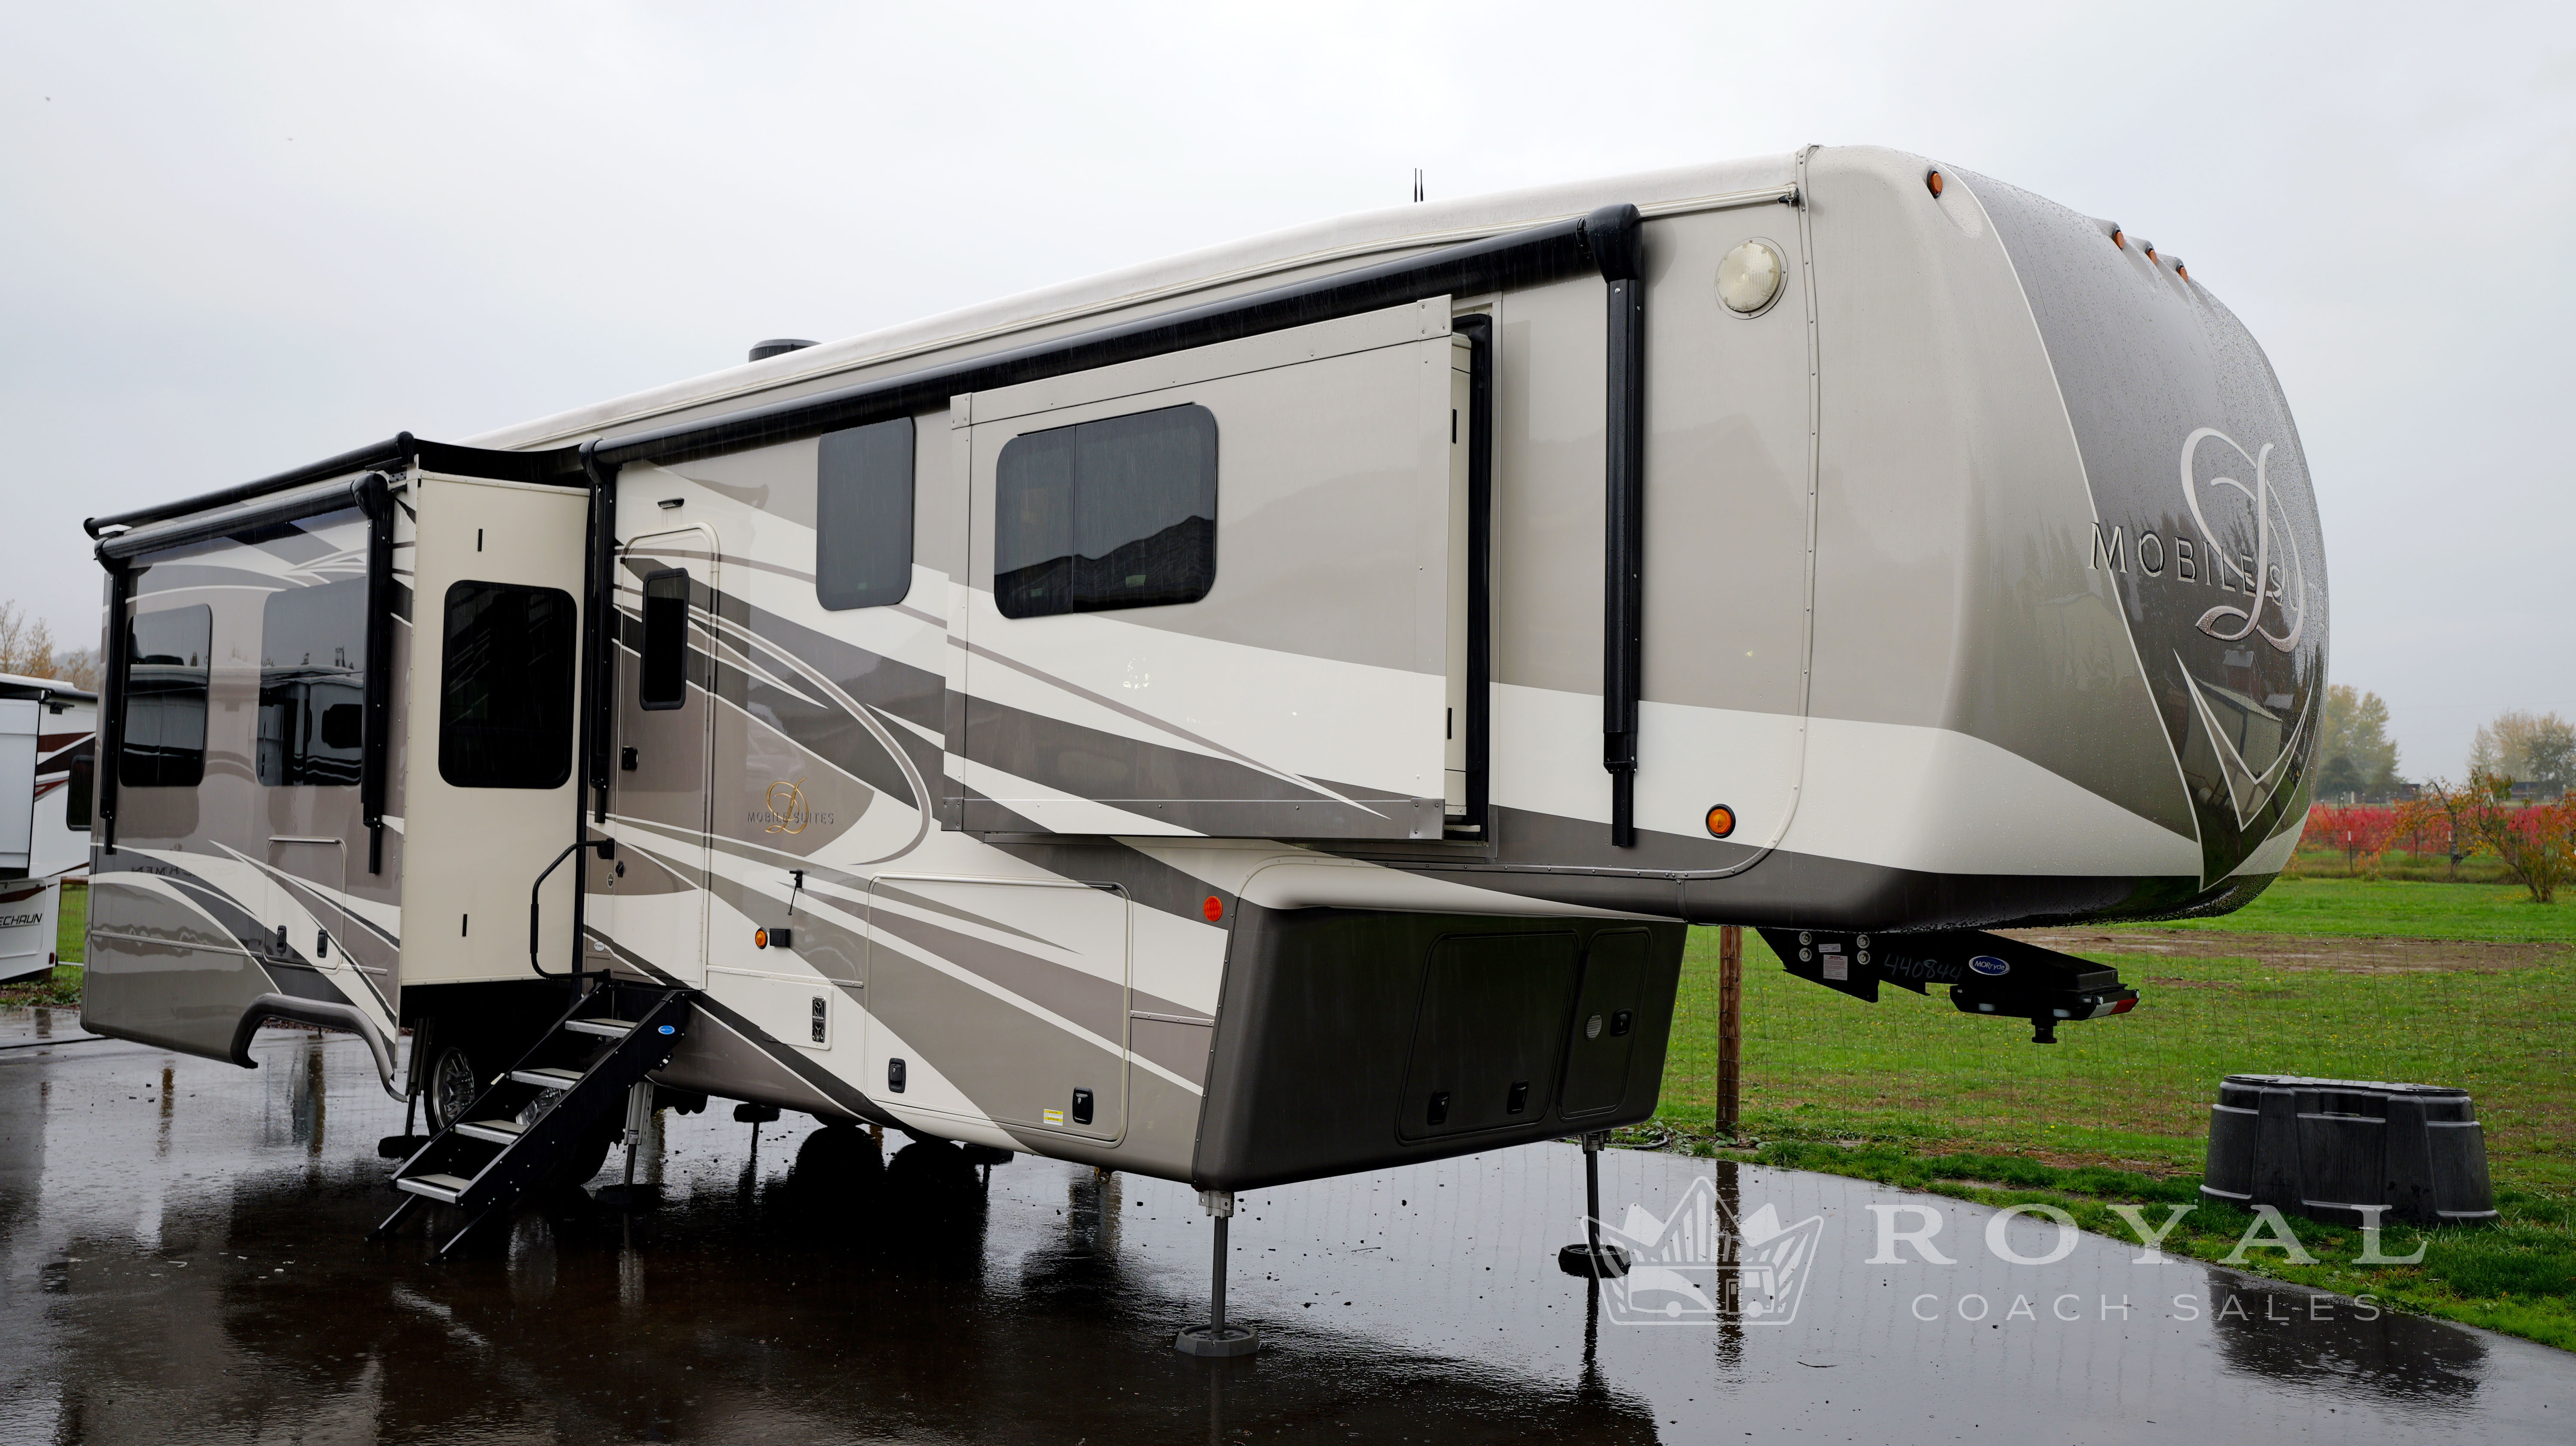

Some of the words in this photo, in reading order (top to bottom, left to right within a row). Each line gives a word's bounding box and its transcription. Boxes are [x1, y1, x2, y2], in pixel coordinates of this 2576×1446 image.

[2087, 521, 2257, 598] MOBILE
[747, 811, 789, 823] MOBILE
[794, 812, 834, 824] SUITES
[1975, 960, 2005, 970] MORryde
